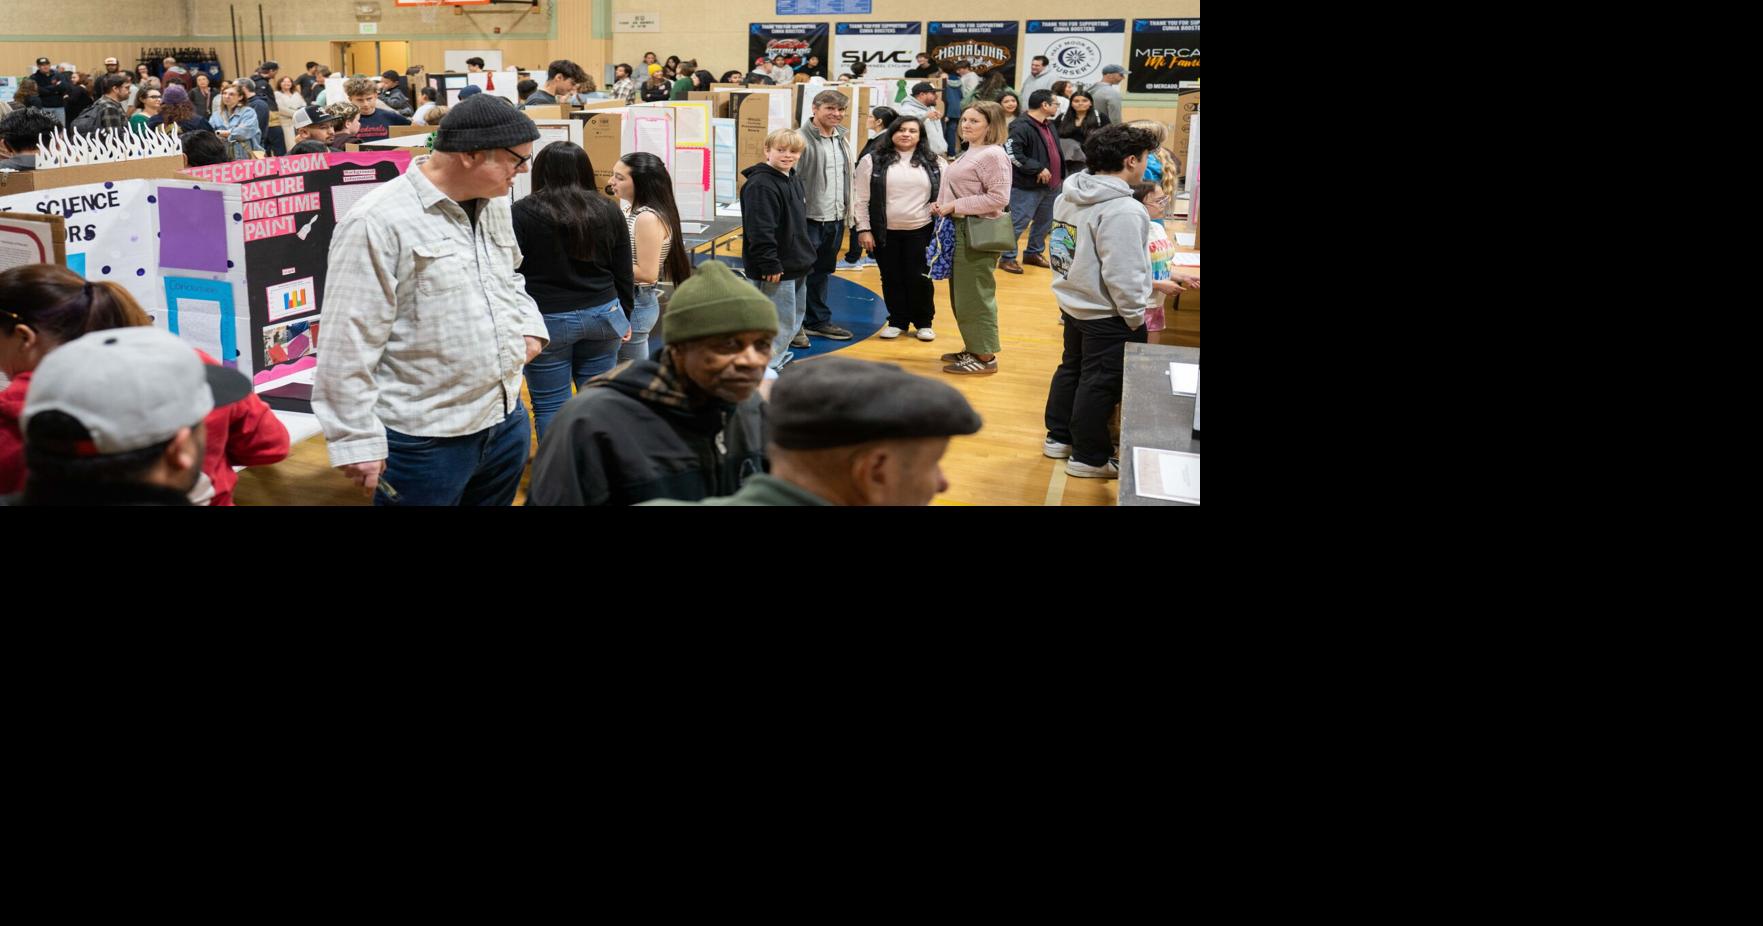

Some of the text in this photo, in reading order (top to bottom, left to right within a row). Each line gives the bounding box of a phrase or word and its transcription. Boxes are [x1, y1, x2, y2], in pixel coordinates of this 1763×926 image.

[842, 51, 912, 63] SWC
[1051, 44, 1062, 56] HALF
[1086, 46, 1095, 56] BAY
[1135, 48, 1200, 57] MERCA
[1051, 63, 1092, 75] NURSERY
[254, 158, 277, 177] OF
[279, 153, 330, 176] ROOM
[36, 191, 120, 216] SCIENCE
[280, 193, 320, 215] TIME
[244, 215, 296, 238] PAINT
